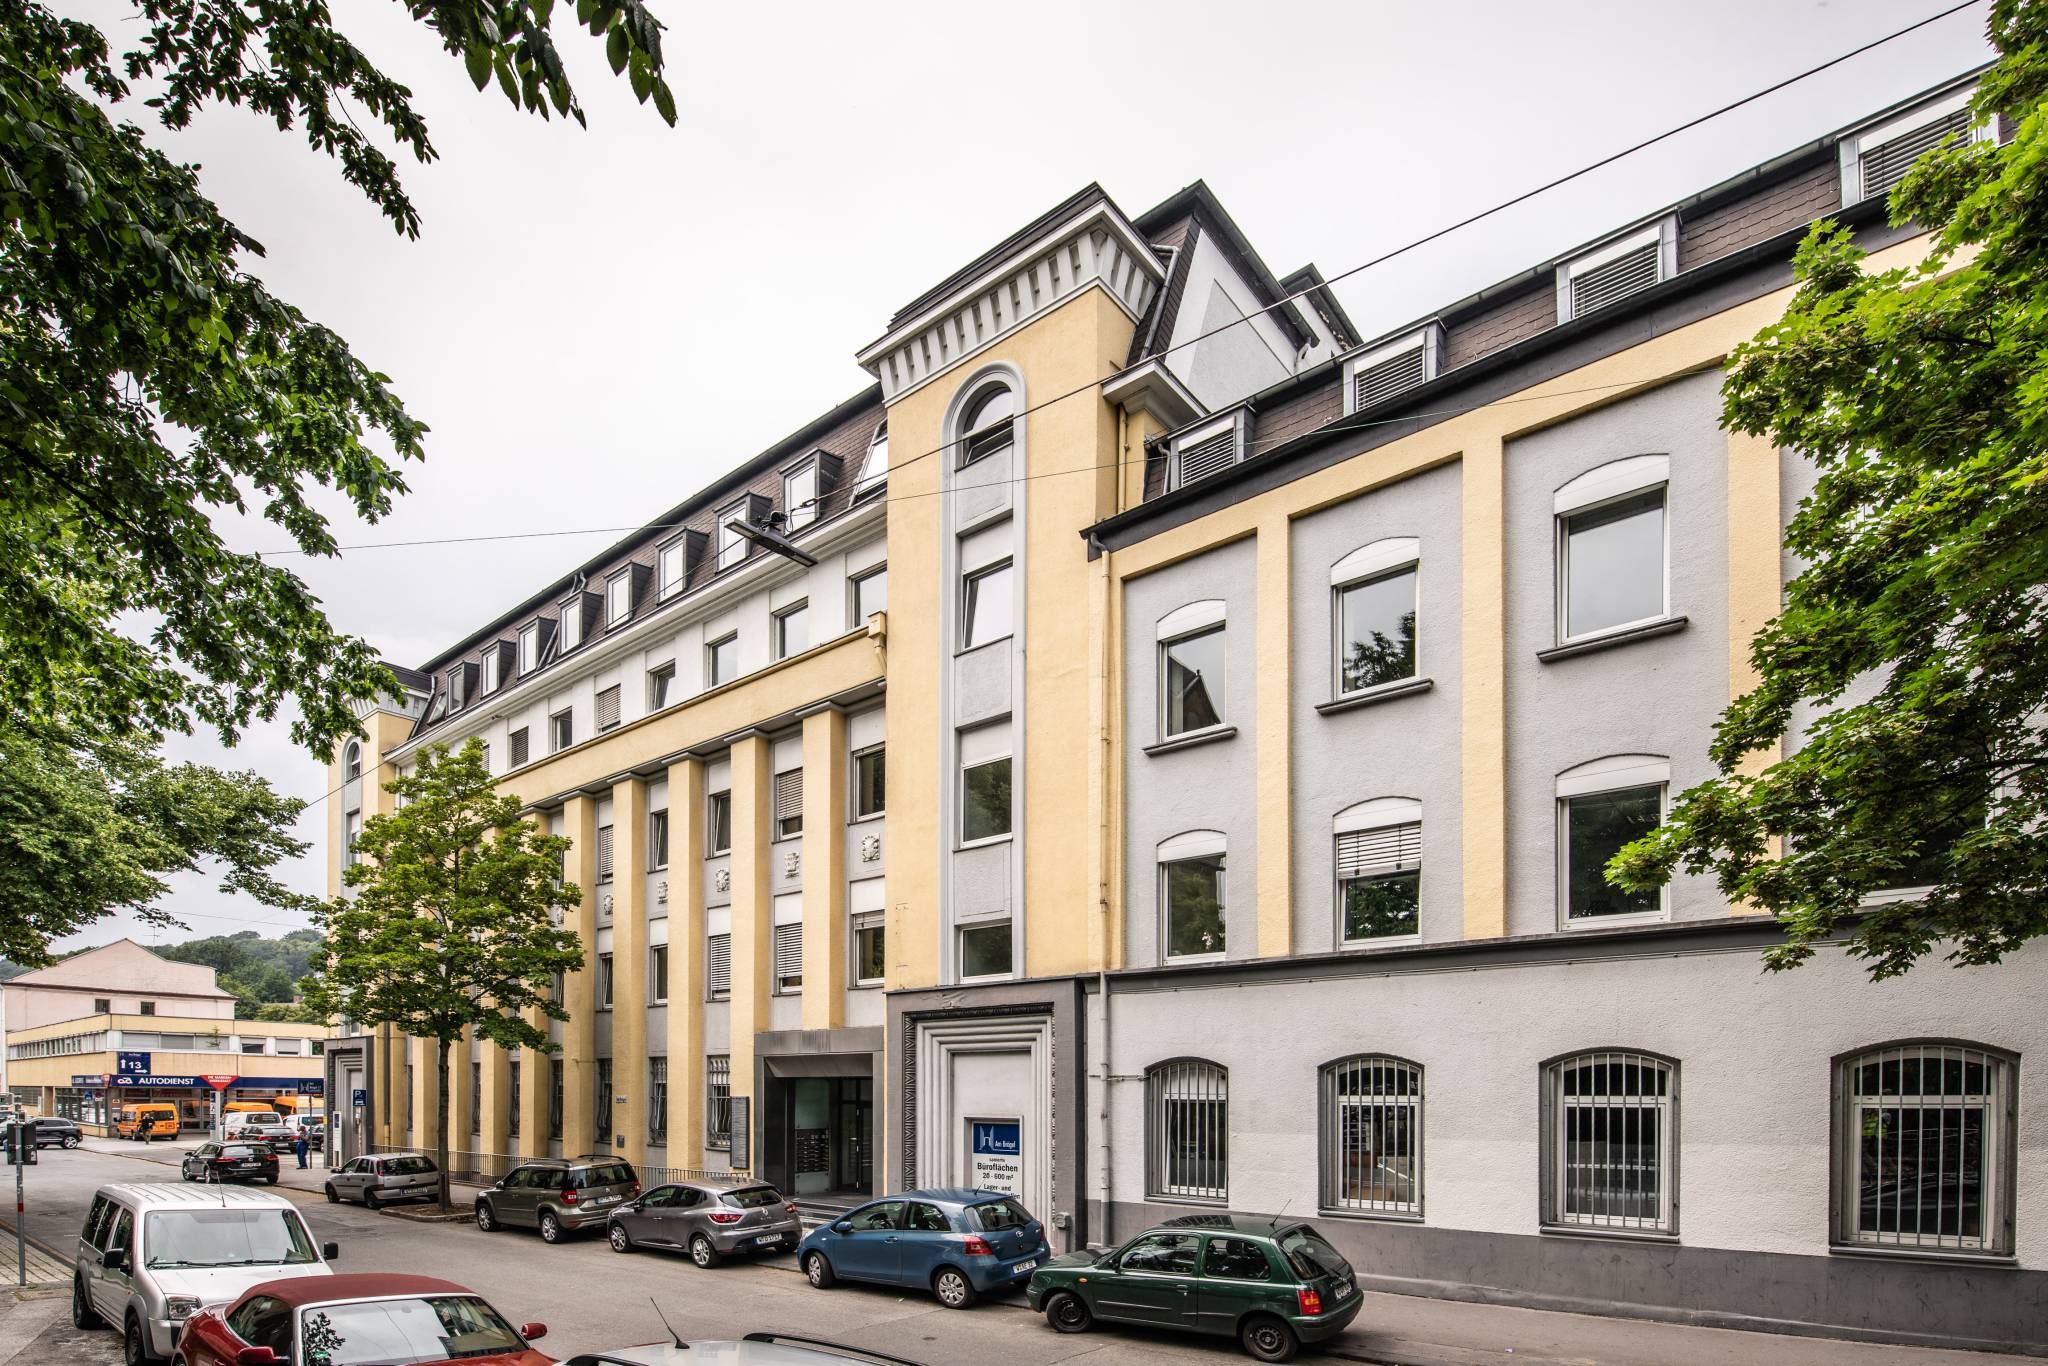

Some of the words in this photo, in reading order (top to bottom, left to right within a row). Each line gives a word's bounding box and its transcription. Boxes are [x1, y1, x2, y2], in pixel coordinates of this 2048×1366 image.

[128, 1061, 142, 1069] 13
[138, 1077, 195, 1085] AUTODIENST
[977, 1162, 1018, 1172] Büroflächen
